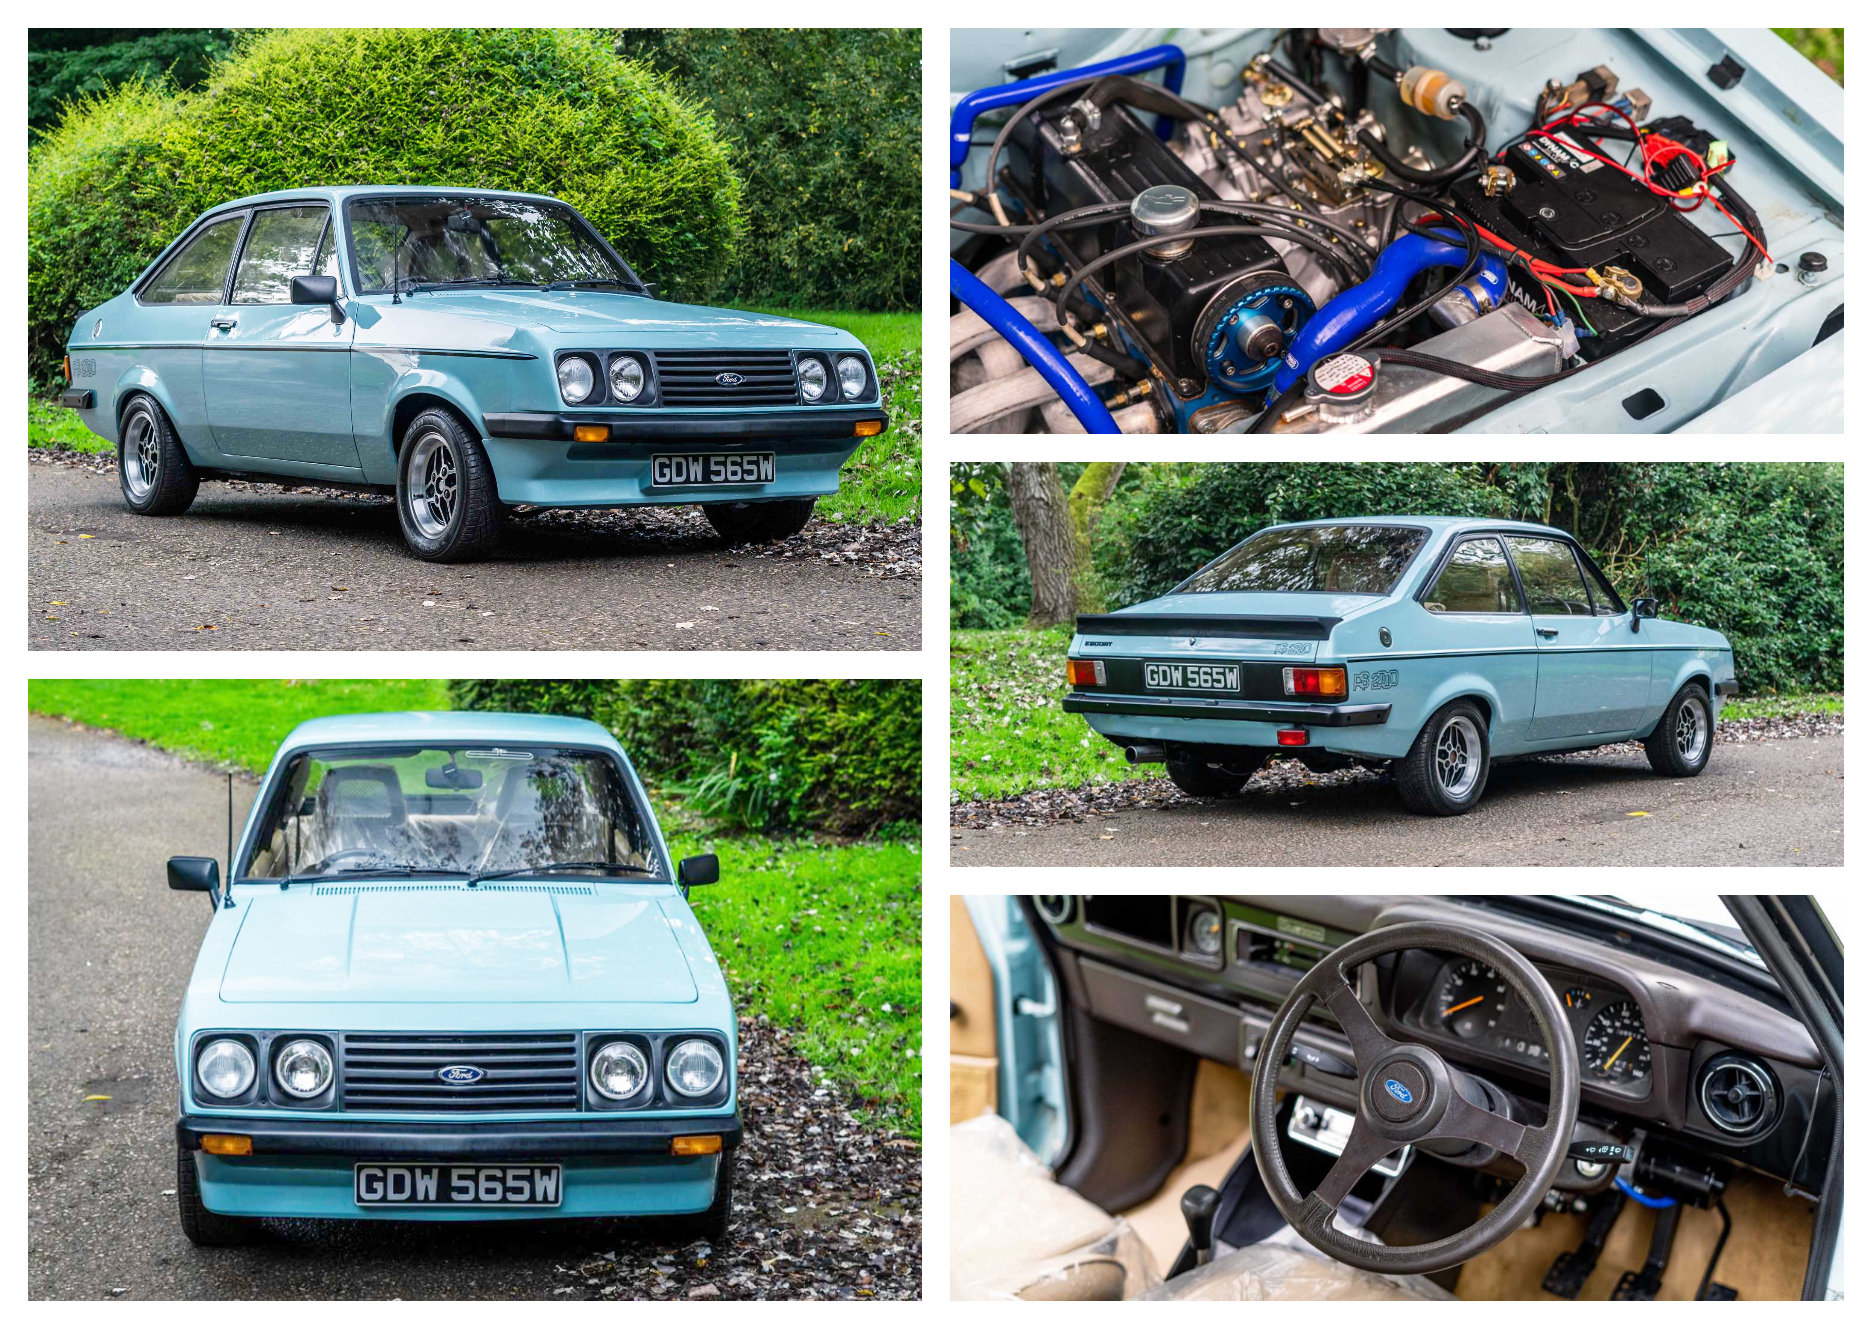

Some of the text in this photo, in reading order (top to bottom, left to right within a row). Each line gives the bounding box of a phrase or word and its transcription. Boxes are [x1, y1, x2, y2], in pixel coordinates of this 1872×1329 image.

[654, 455, 773, 483] GDW 565W
[1147, 665, 1238, 689] GDW 565W
[448, 1068, 474, 1079] Ford
[1390, 1083, 1409, 1099] Ford
[359, 1167, 558, 1202] GDW 565W
